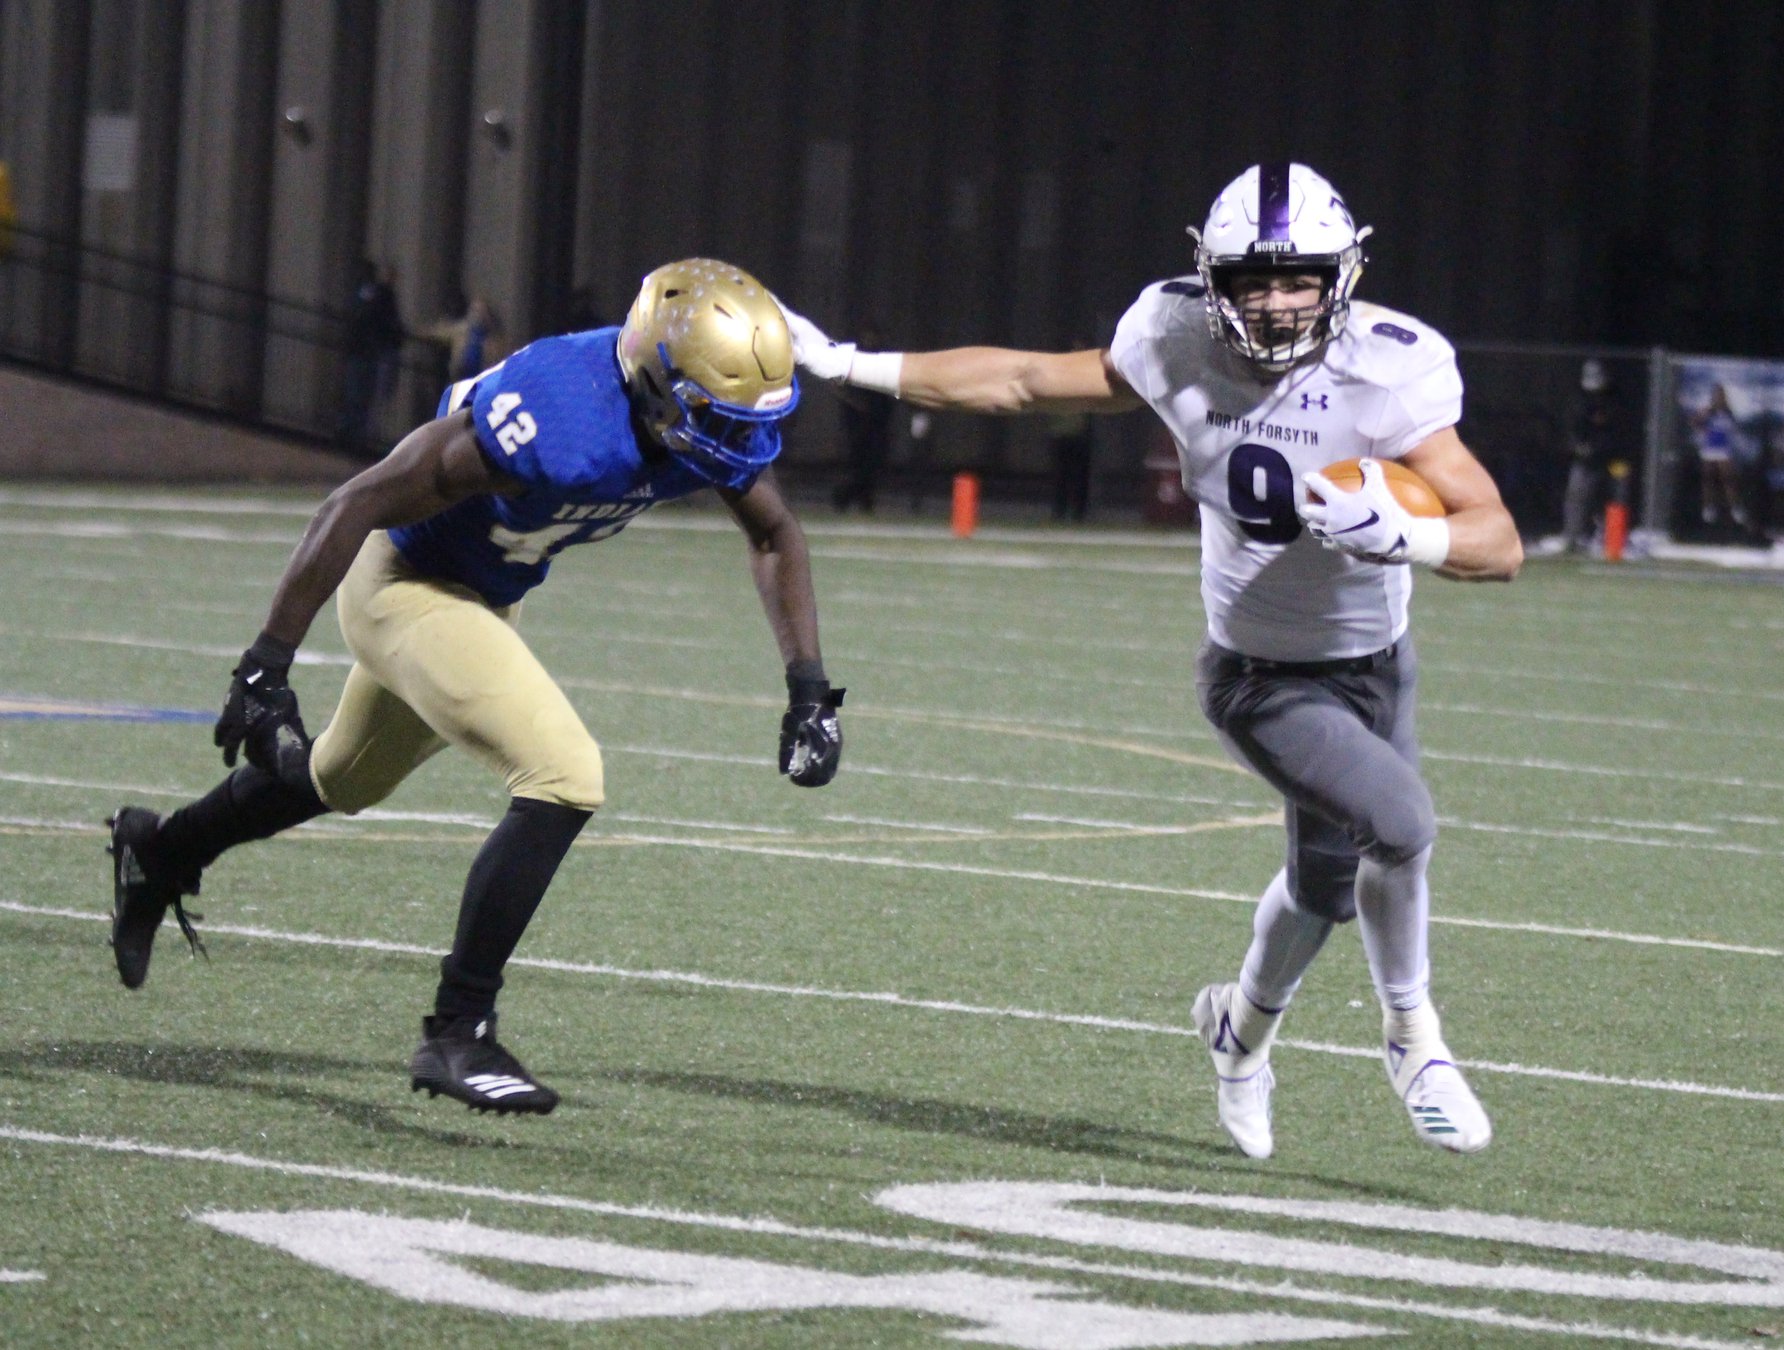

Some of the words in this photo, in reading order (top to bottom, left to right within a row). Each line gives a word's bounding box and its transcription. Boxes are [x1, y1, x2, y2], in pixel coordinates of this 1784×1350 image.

[1254, 241, 1292, 253] NORTH
[486, 392, 538, 456] 42
[1205, 410, 1250, 435] NORTH
[1257, 421, 1319, 446] FORSYTH
[1227, 443, 1303, 545] 9
